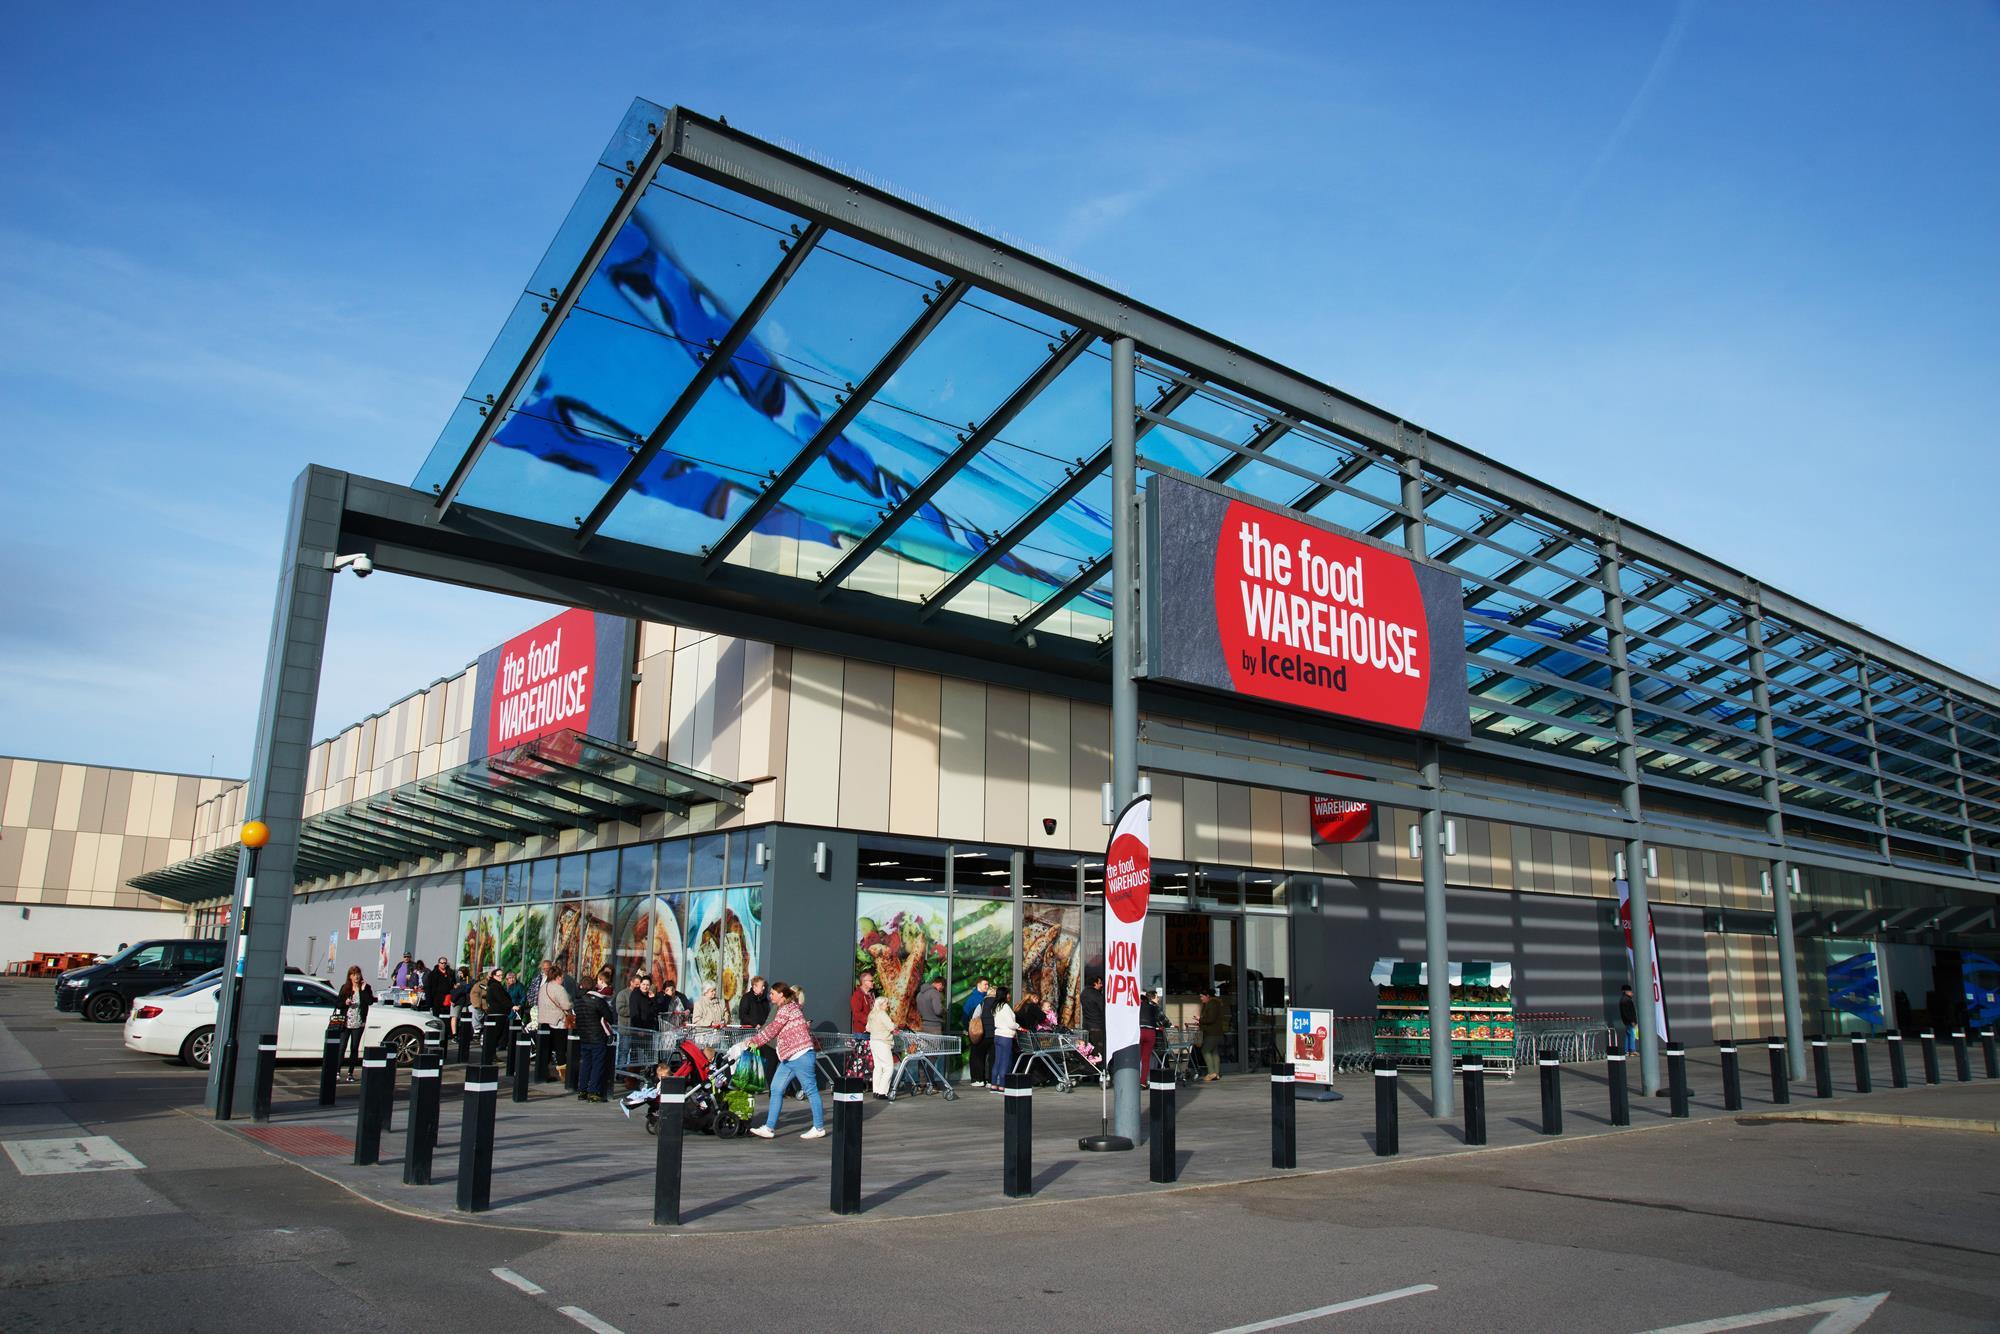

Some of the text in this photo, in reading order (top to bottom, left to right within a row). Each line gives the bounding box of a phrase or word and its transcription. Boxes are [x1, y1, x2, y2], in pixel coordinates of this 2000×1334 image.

[1239, 522, 1364, 608] the food
[1240, 580, 1421, 679] WAREHOUSE
[502, 628, 562, 696] the food
[1242, 647, 1347, 692] by Iceland
[499, 666, 588, 742] WAREHOUSE
[1315, 801, 1367, 816] WAREHOUSE
[1106, 856, 1135, 879] the food
[1108, 868, 1150, 894] WAREHOUS
